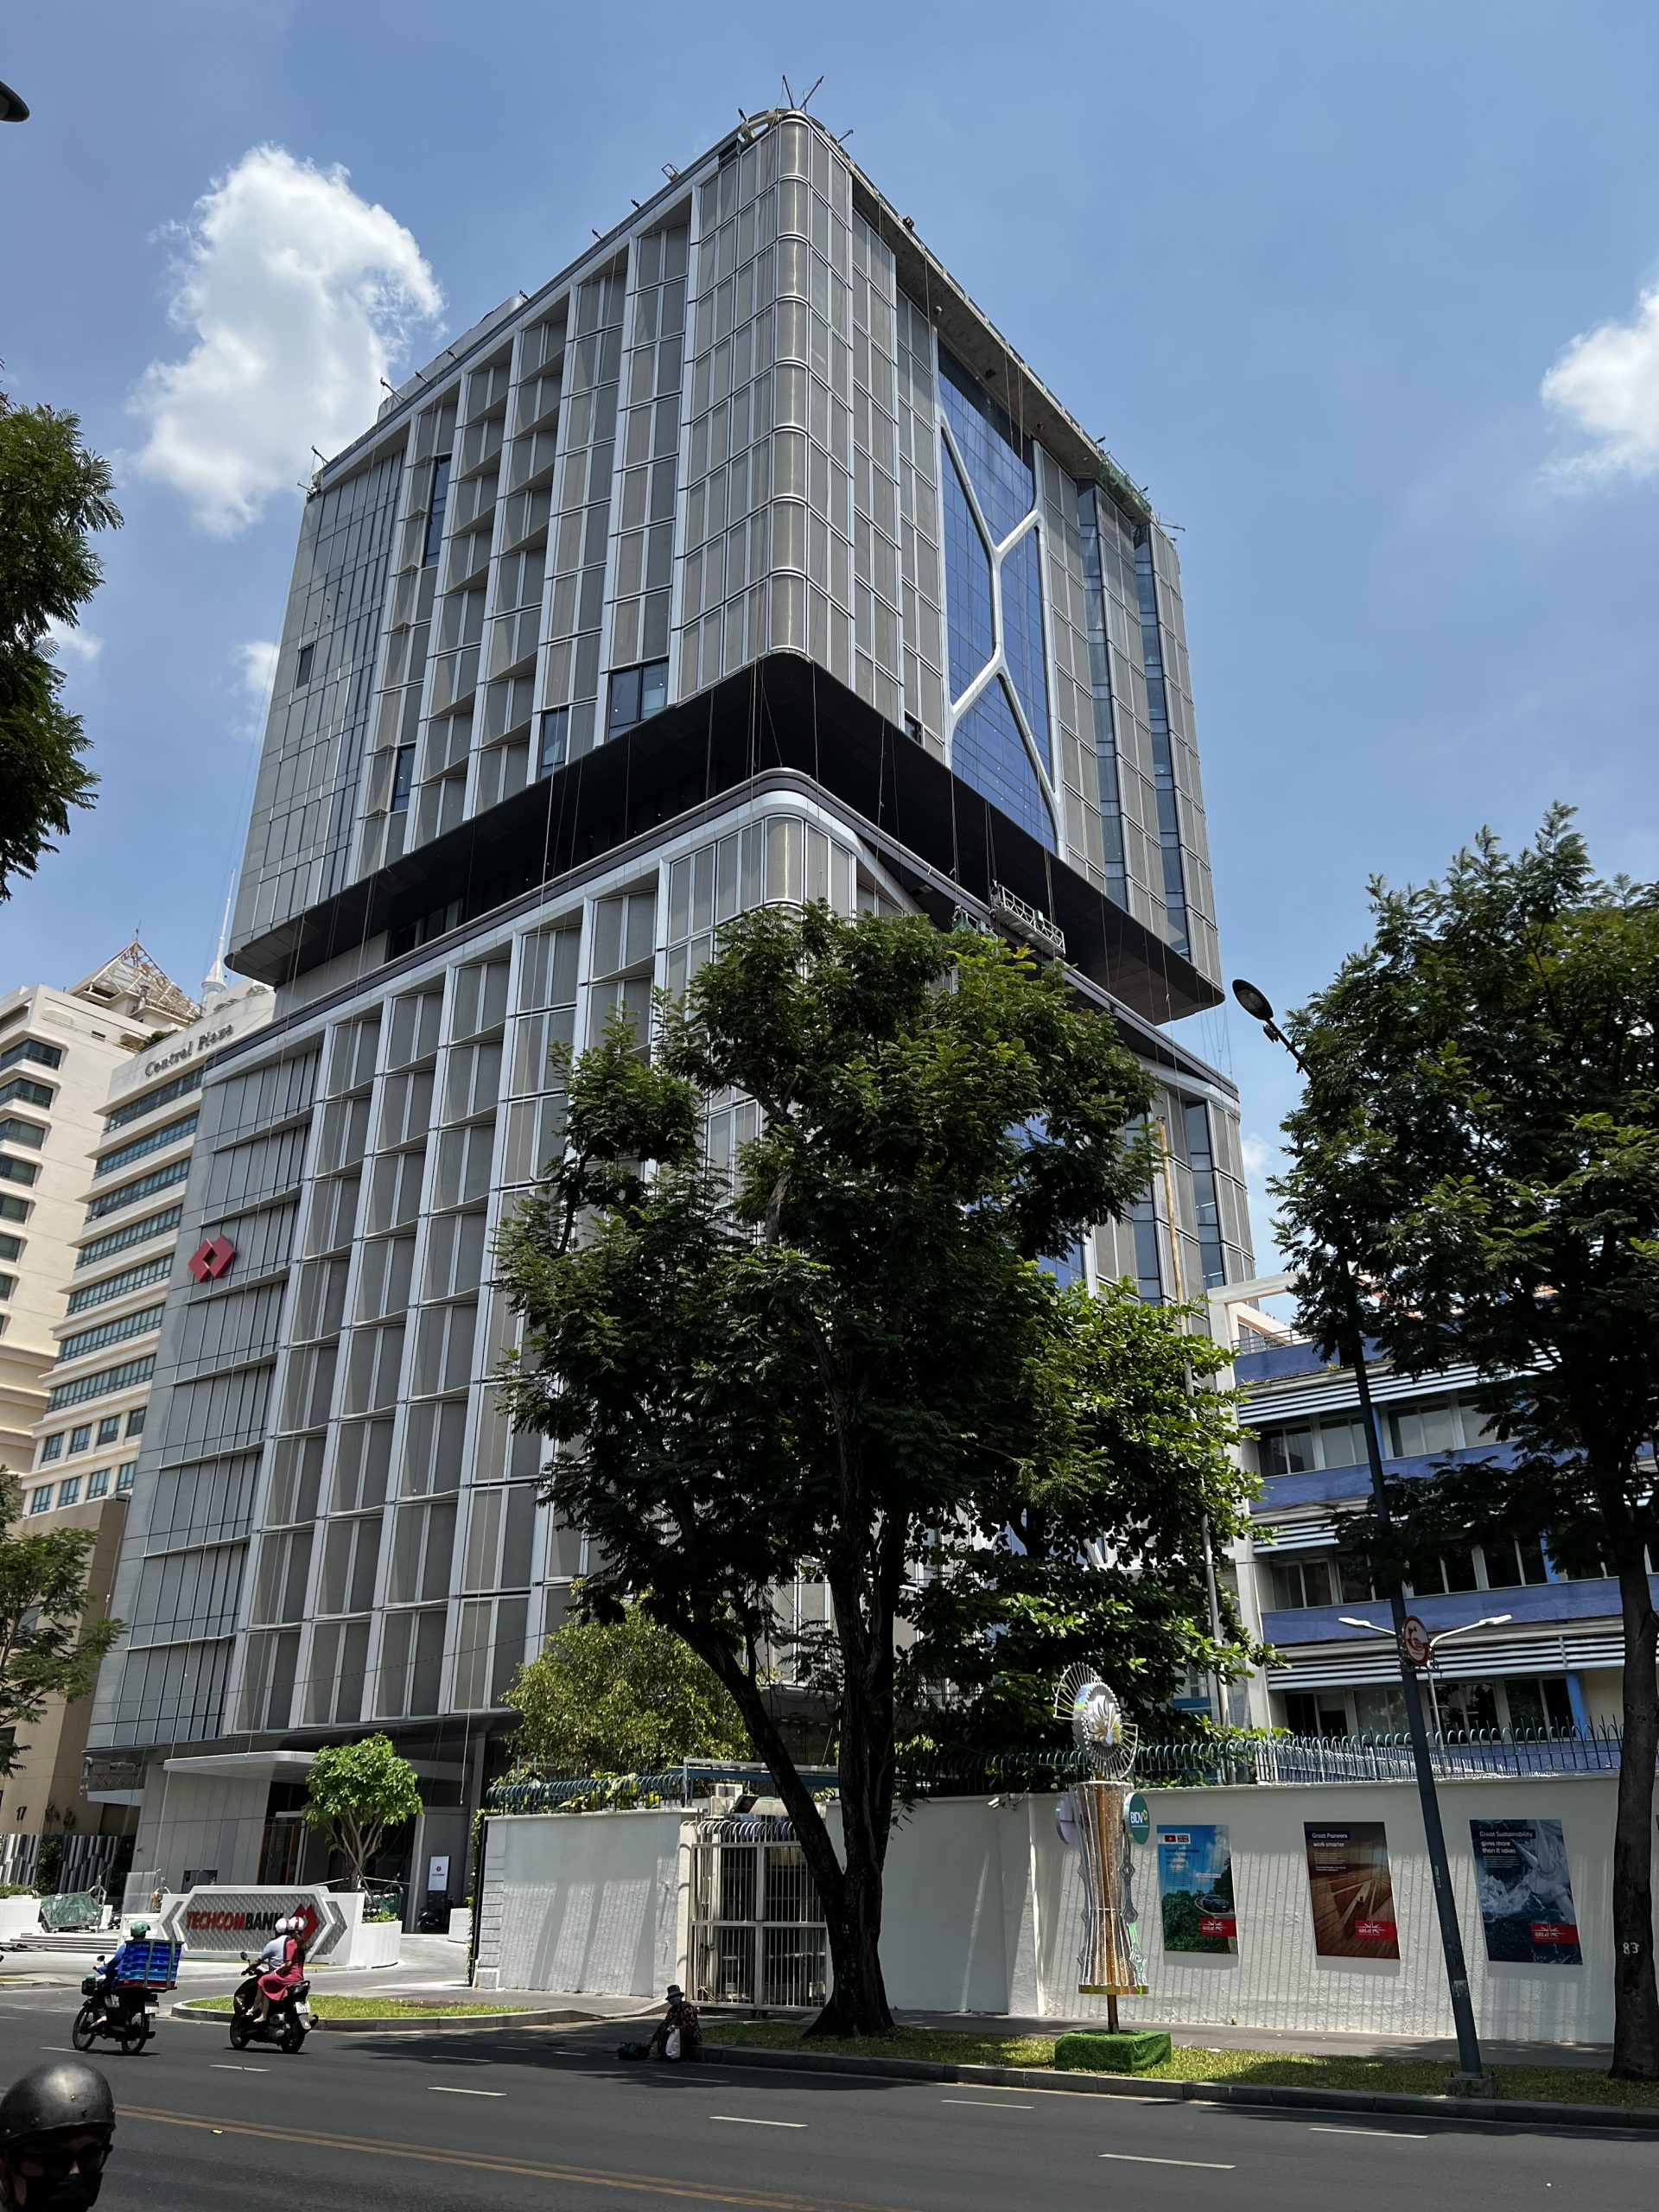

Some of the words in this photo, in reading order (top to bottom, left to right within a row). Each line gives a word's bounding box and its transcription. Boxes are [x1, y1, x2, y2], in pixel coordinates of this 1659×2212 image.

[144, 1040, 194, 1077] Central
[197, 1024, 234, 1052] Plaza
[16, 1806, 28, 1821] 17
[1129, 1811, 1143, 1824] BIDV
[1622, 1942, 1639, 1955] 83
